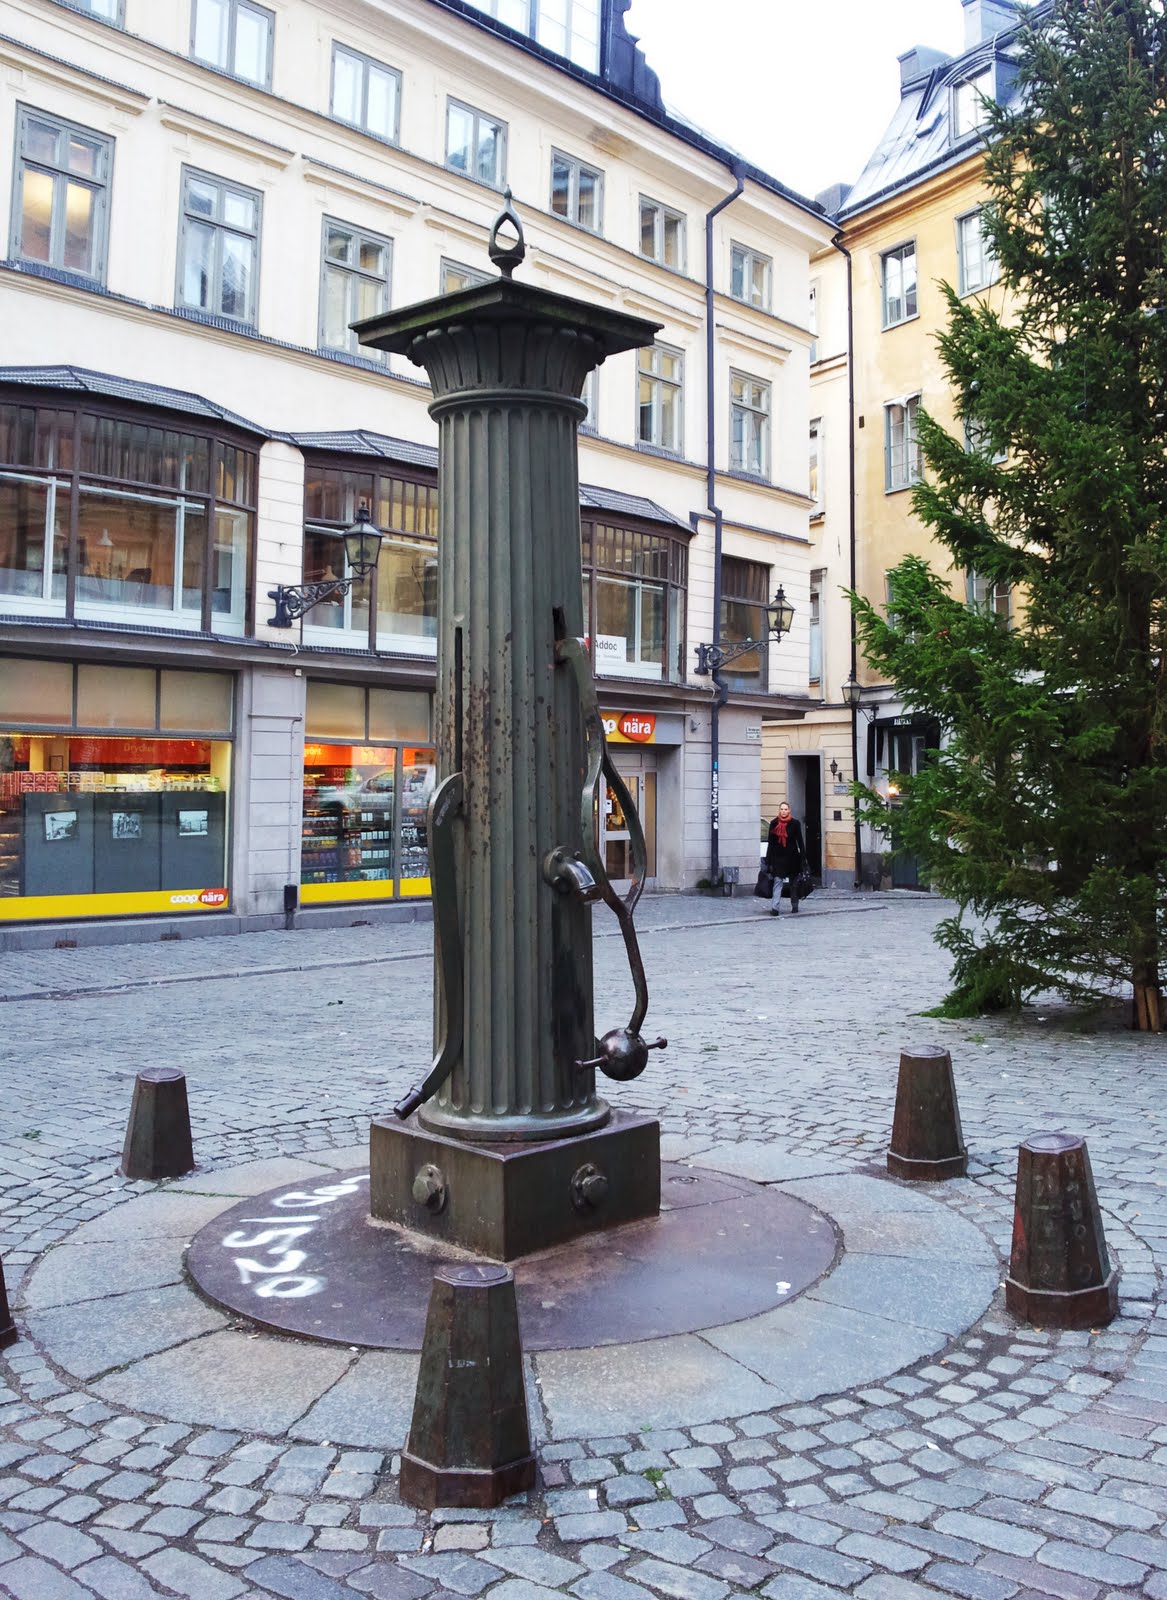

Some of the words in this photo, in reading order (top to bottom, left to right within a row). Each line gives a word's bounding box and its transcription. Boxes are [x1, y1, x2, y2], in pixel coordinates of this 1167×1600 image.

[623, 718, 651, 734] nära
[170, 894, 198, 904] coop
[201, 892, 224, 902] nära
